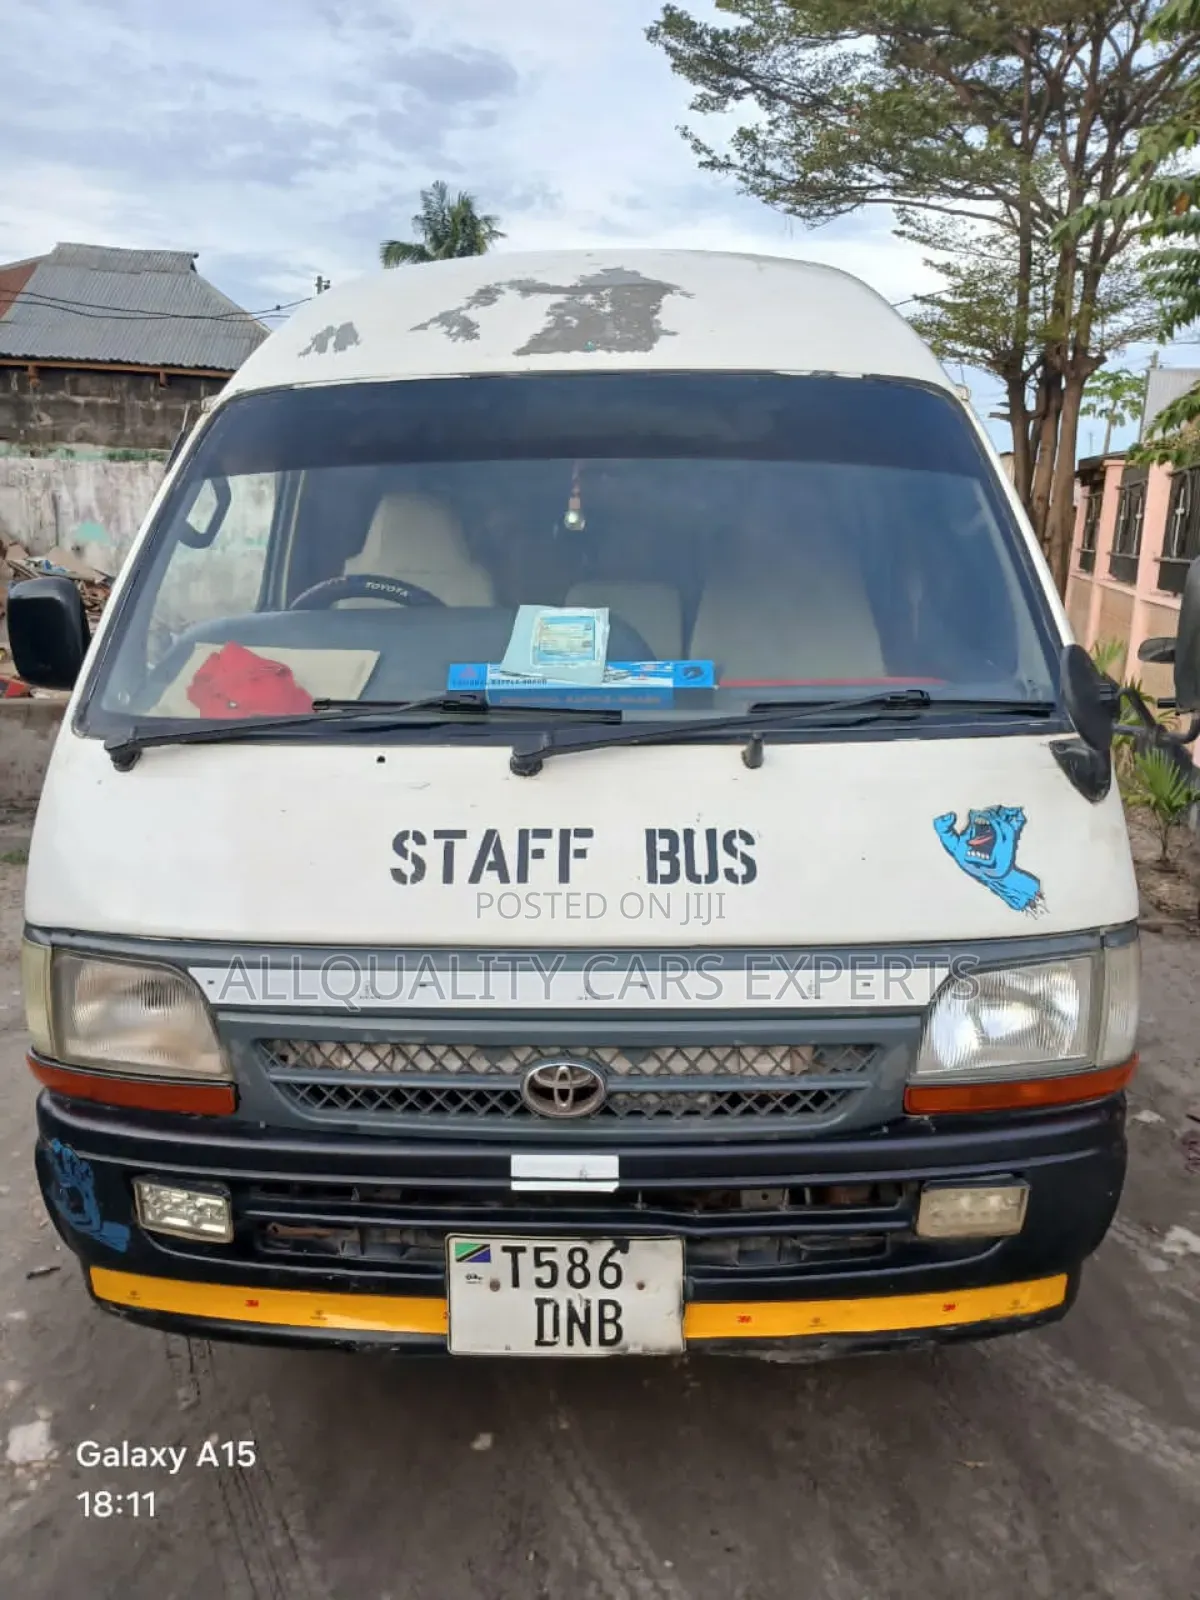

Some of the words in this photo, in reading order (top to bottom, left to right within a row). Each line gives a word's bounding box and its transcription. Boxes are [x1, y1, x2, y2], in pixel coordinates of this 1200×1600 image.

[366, 581, 408, 597] TOYOTA
[390, 828, 594, 885] STAFF
[645, 828, 757, 885] BUS
[502, 1246, 623, 1290] T586
[535, 1297, 624, 1347] DNB
